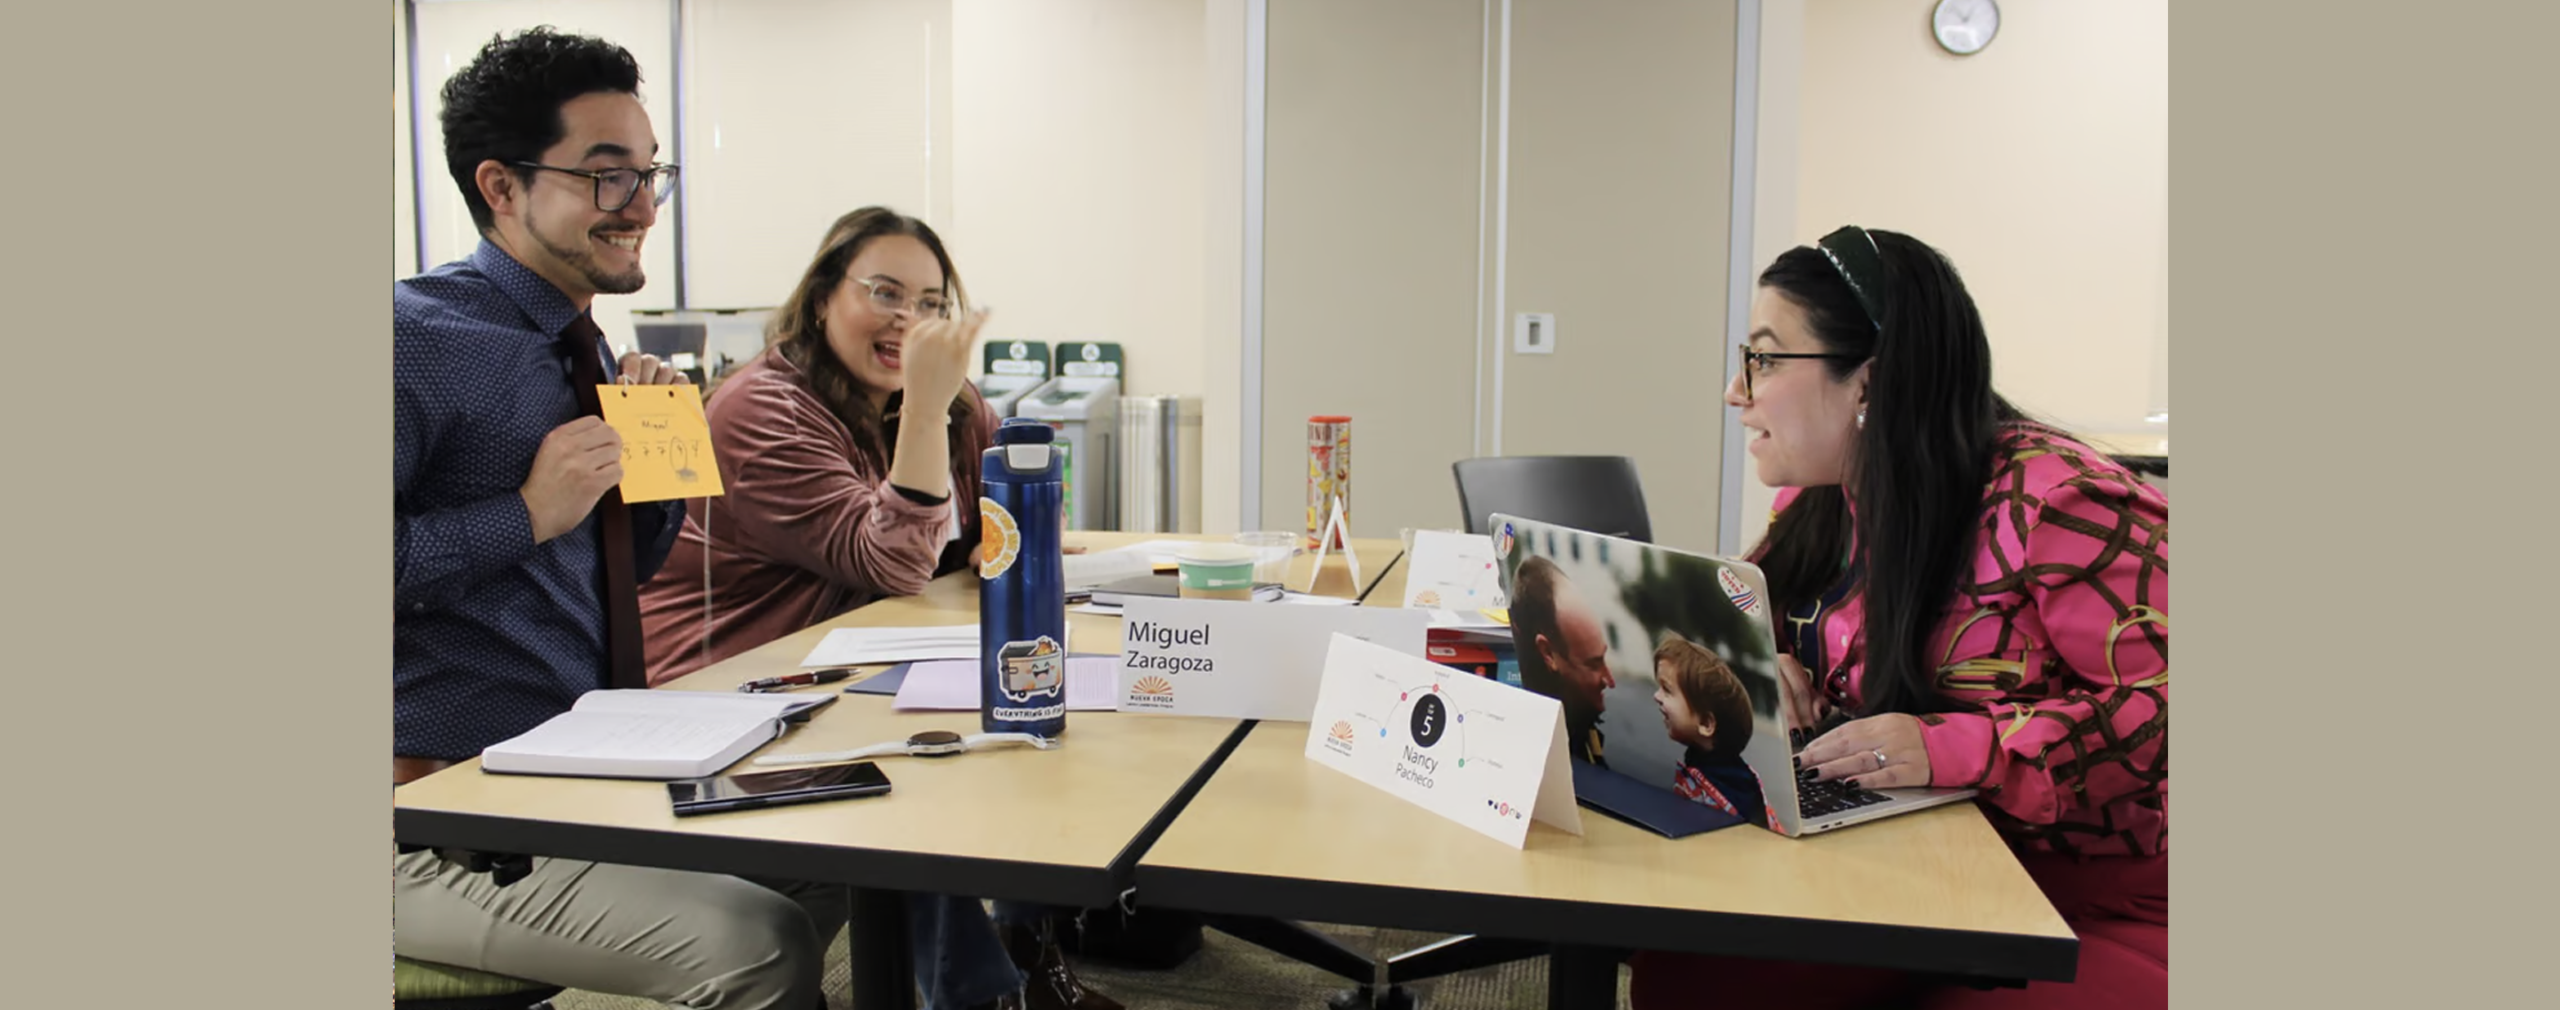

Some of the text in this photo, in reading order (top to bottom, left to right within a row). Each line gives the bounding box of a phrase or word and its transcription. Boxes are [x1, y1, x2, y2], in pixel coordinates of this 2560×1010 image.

[1129, 621, 1209, 649] Miguel
[1127, 650, 1213, 675] Zaragoza
[995, 708, 1043, 718] EVERYTHING
[1044, 708, 1051, 716] IS
[1421, 715, 1433, 736] 5
[1402, 745, 1438, 775] Nancy
[1395, 762, 1434, 789] Pacheco
